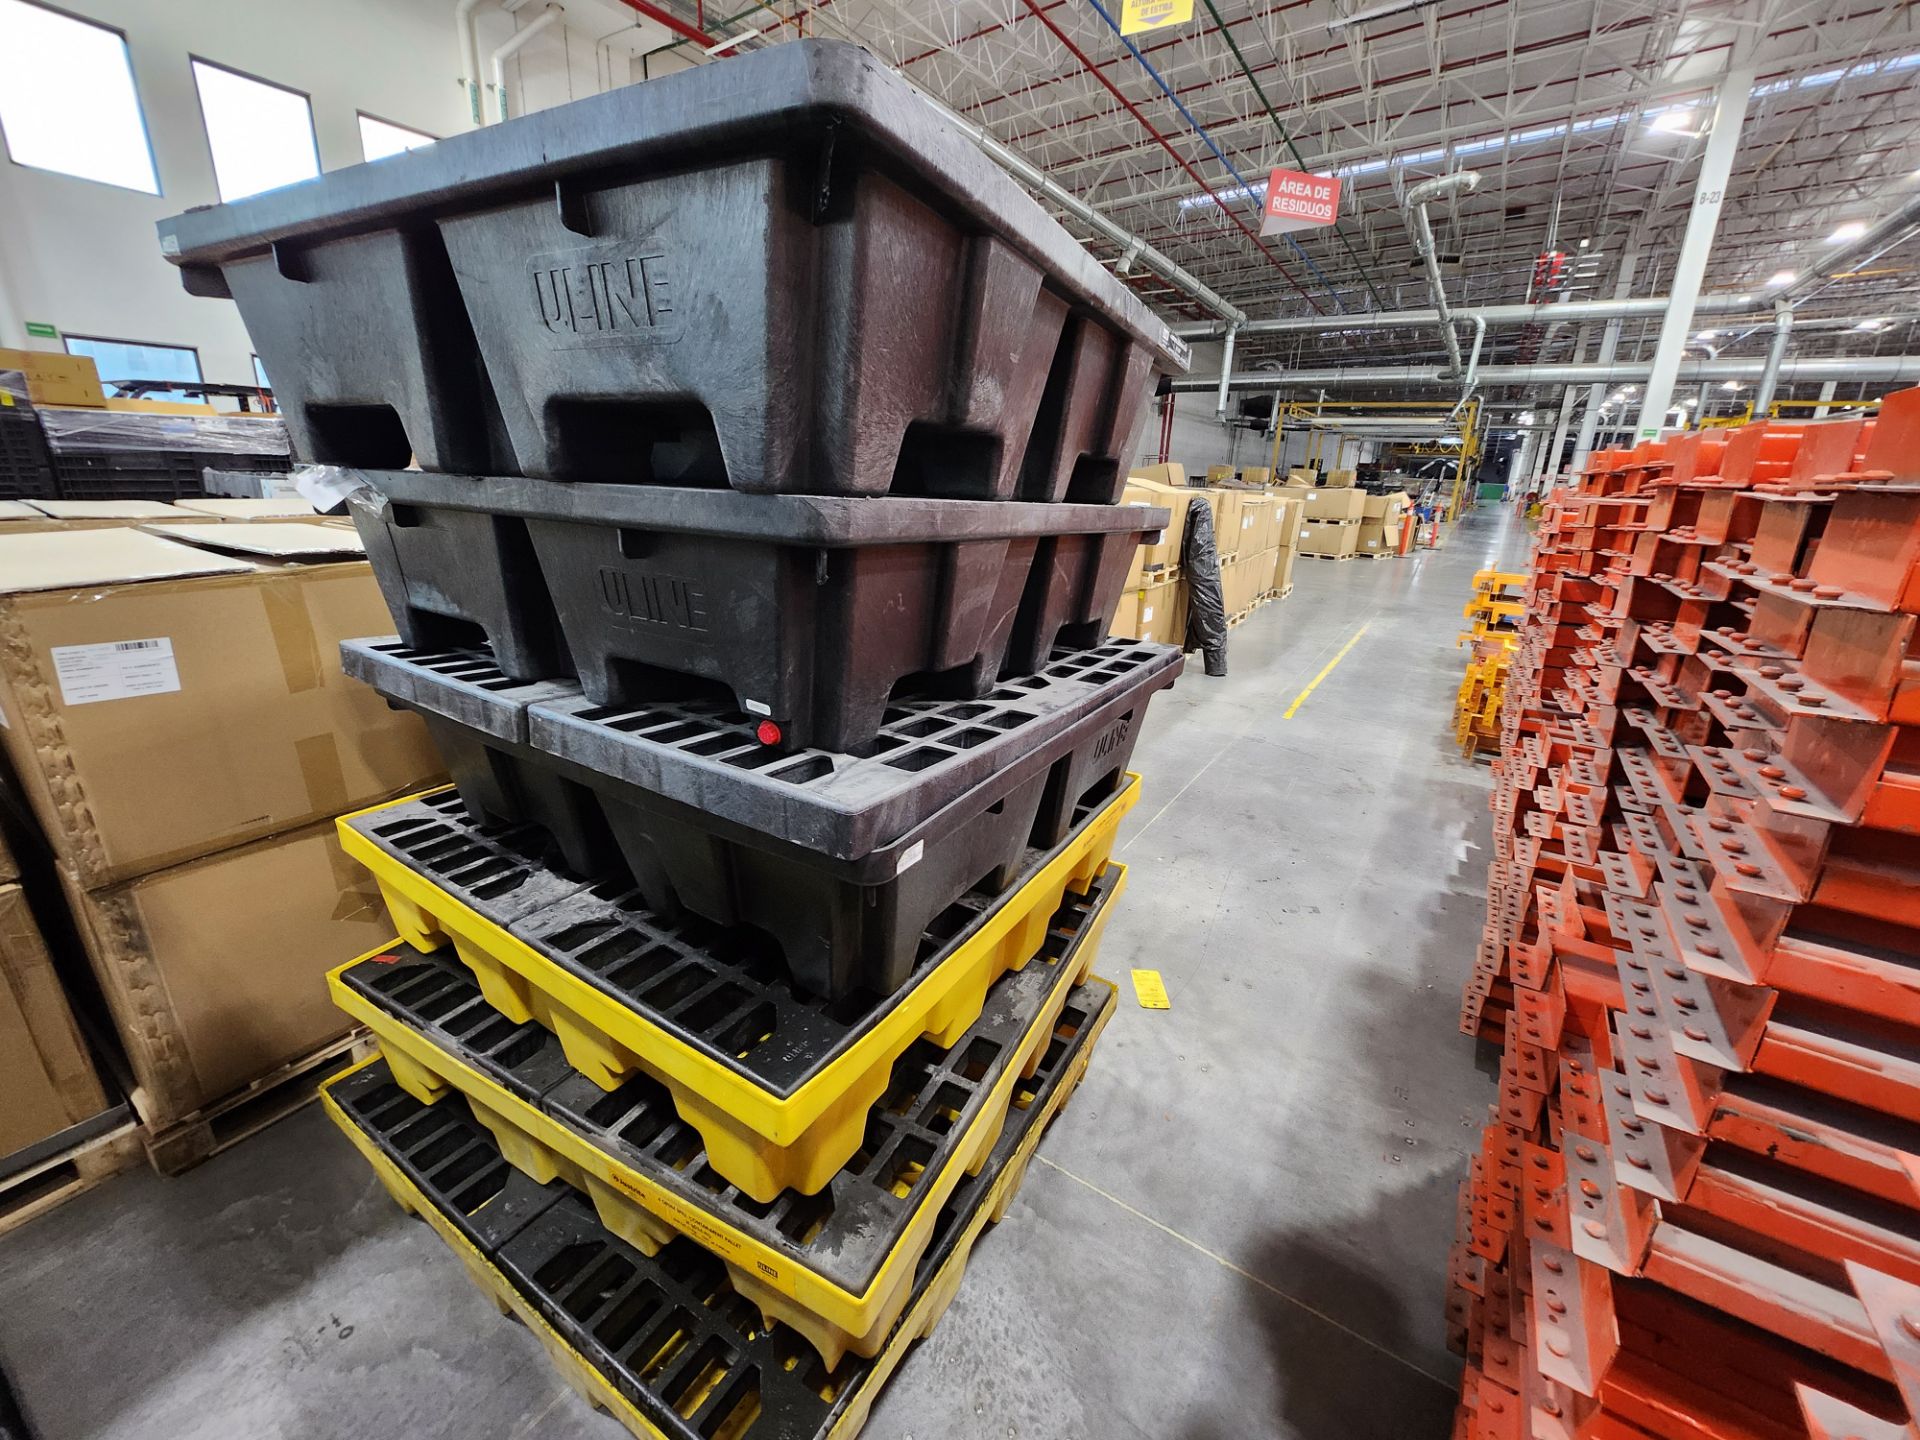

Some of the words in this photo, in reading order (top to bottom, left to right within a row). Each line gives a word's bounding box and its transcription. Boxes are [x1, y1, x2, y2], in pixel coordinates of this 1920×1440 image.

[1278, 177, 1312, 197] ÁREA
[1314, 185, 1331, 200] DE
[1699, 191, 1721, 205] B-23
[1272, 196, 1332, 217] RESIDUOS
[533, 254, 673, 334] ULINE
[599, 568, 709, 632] ULINE
